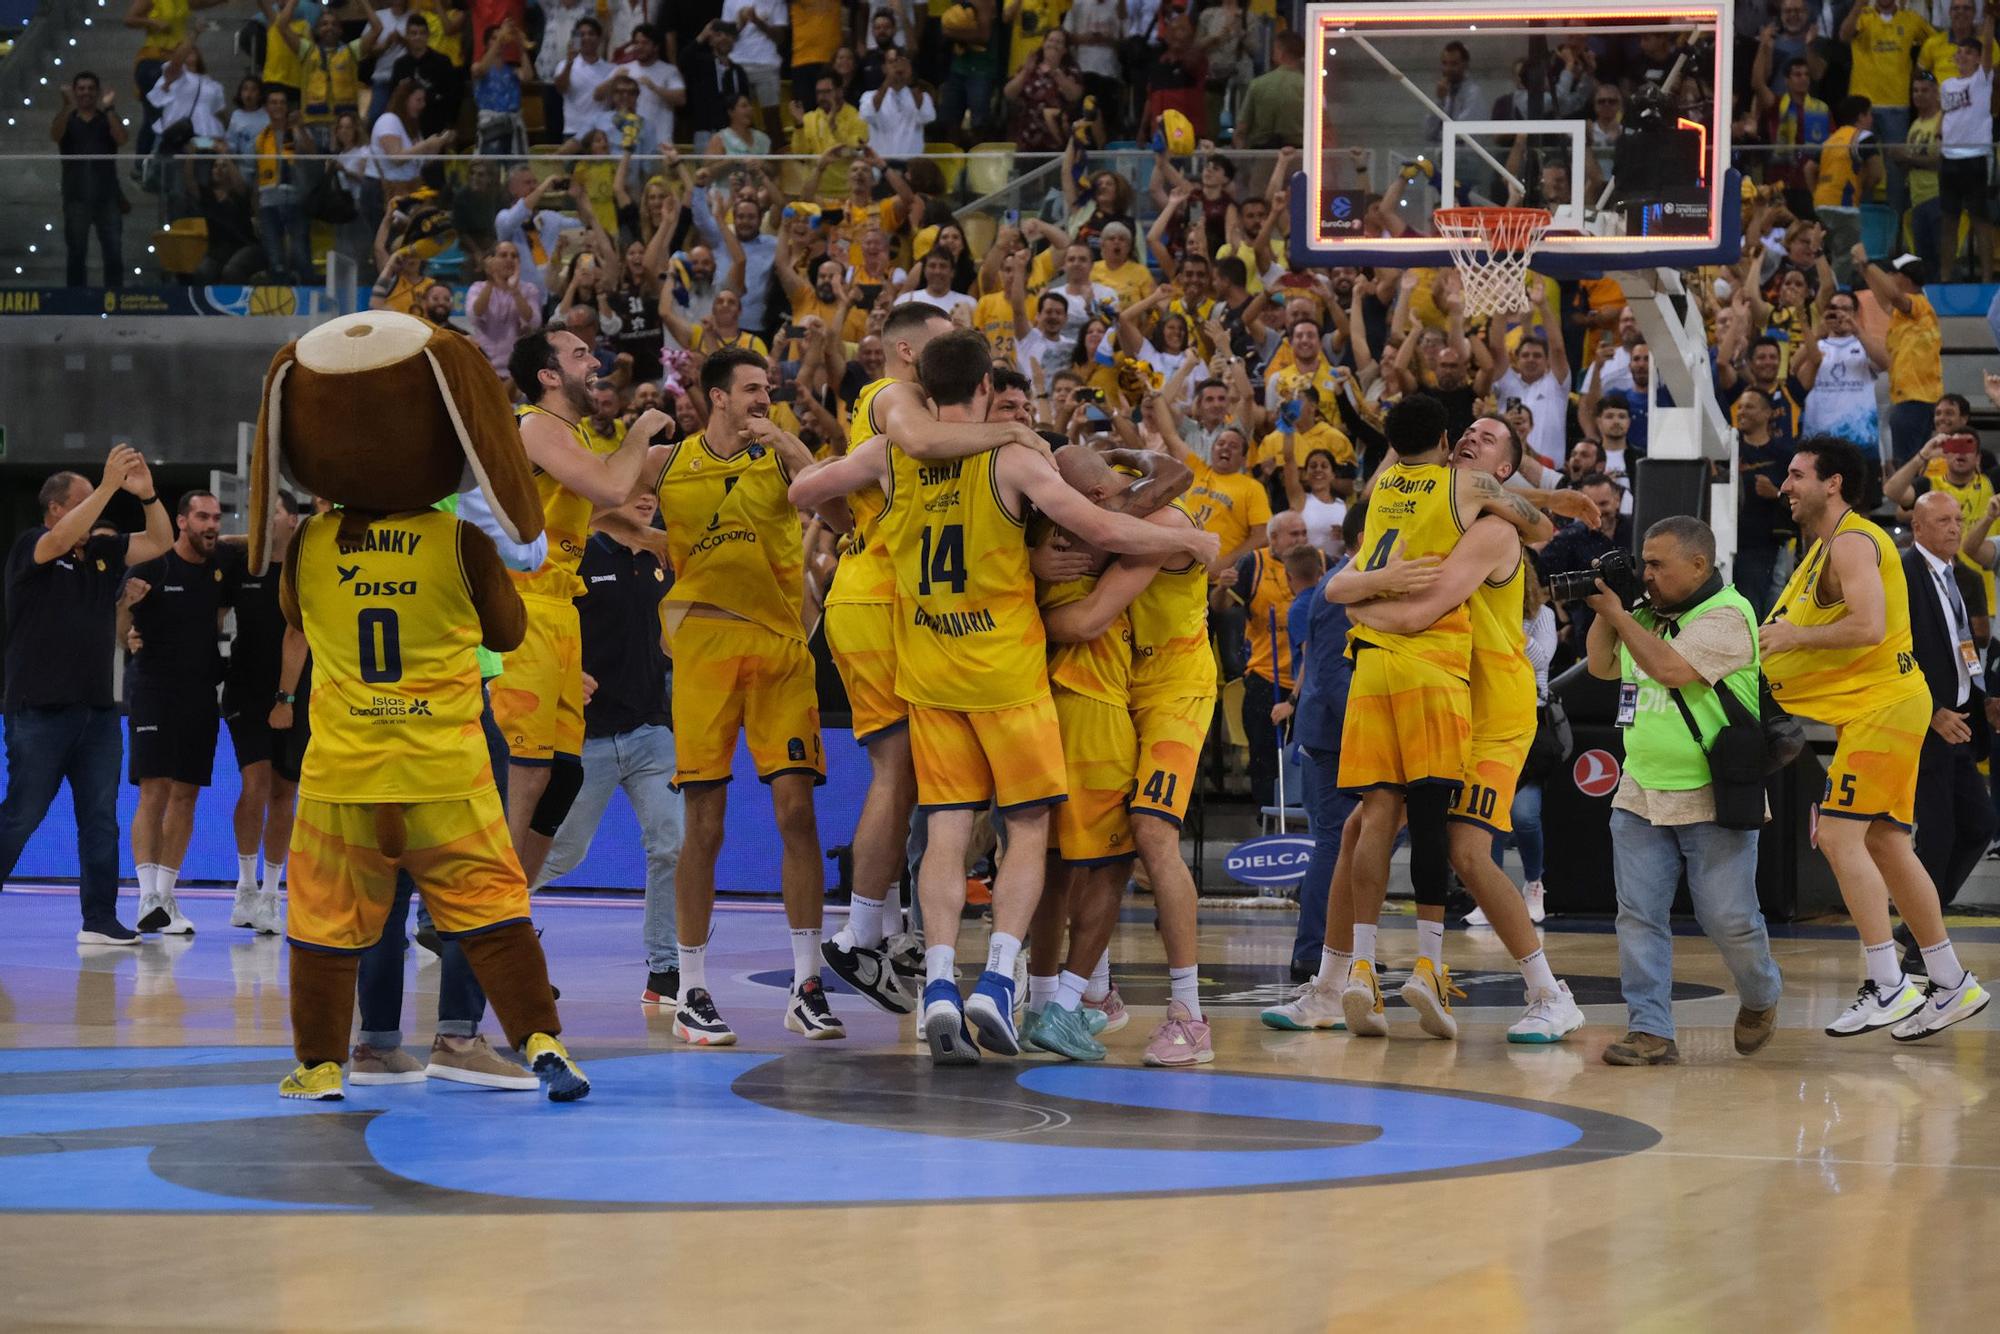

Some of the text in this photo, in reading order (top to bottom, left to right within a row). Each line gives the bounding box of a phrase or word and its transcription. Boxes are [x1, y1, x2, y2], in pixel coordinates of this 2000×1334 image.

[919, 525, 967, 596] 14
[1365, 528, 1400, 571] 4
[358, 608, 402, 684] 0
[349, 705, 407, 716] Canarias
[372, 696, 406, 706] Islas
[1143, 770, 1177, 808] 41
[1466, 784, 1497, 819] 10
[1839, 774, 1856, 807] 5
[1228, 852, 1310, 870] DIELCA
